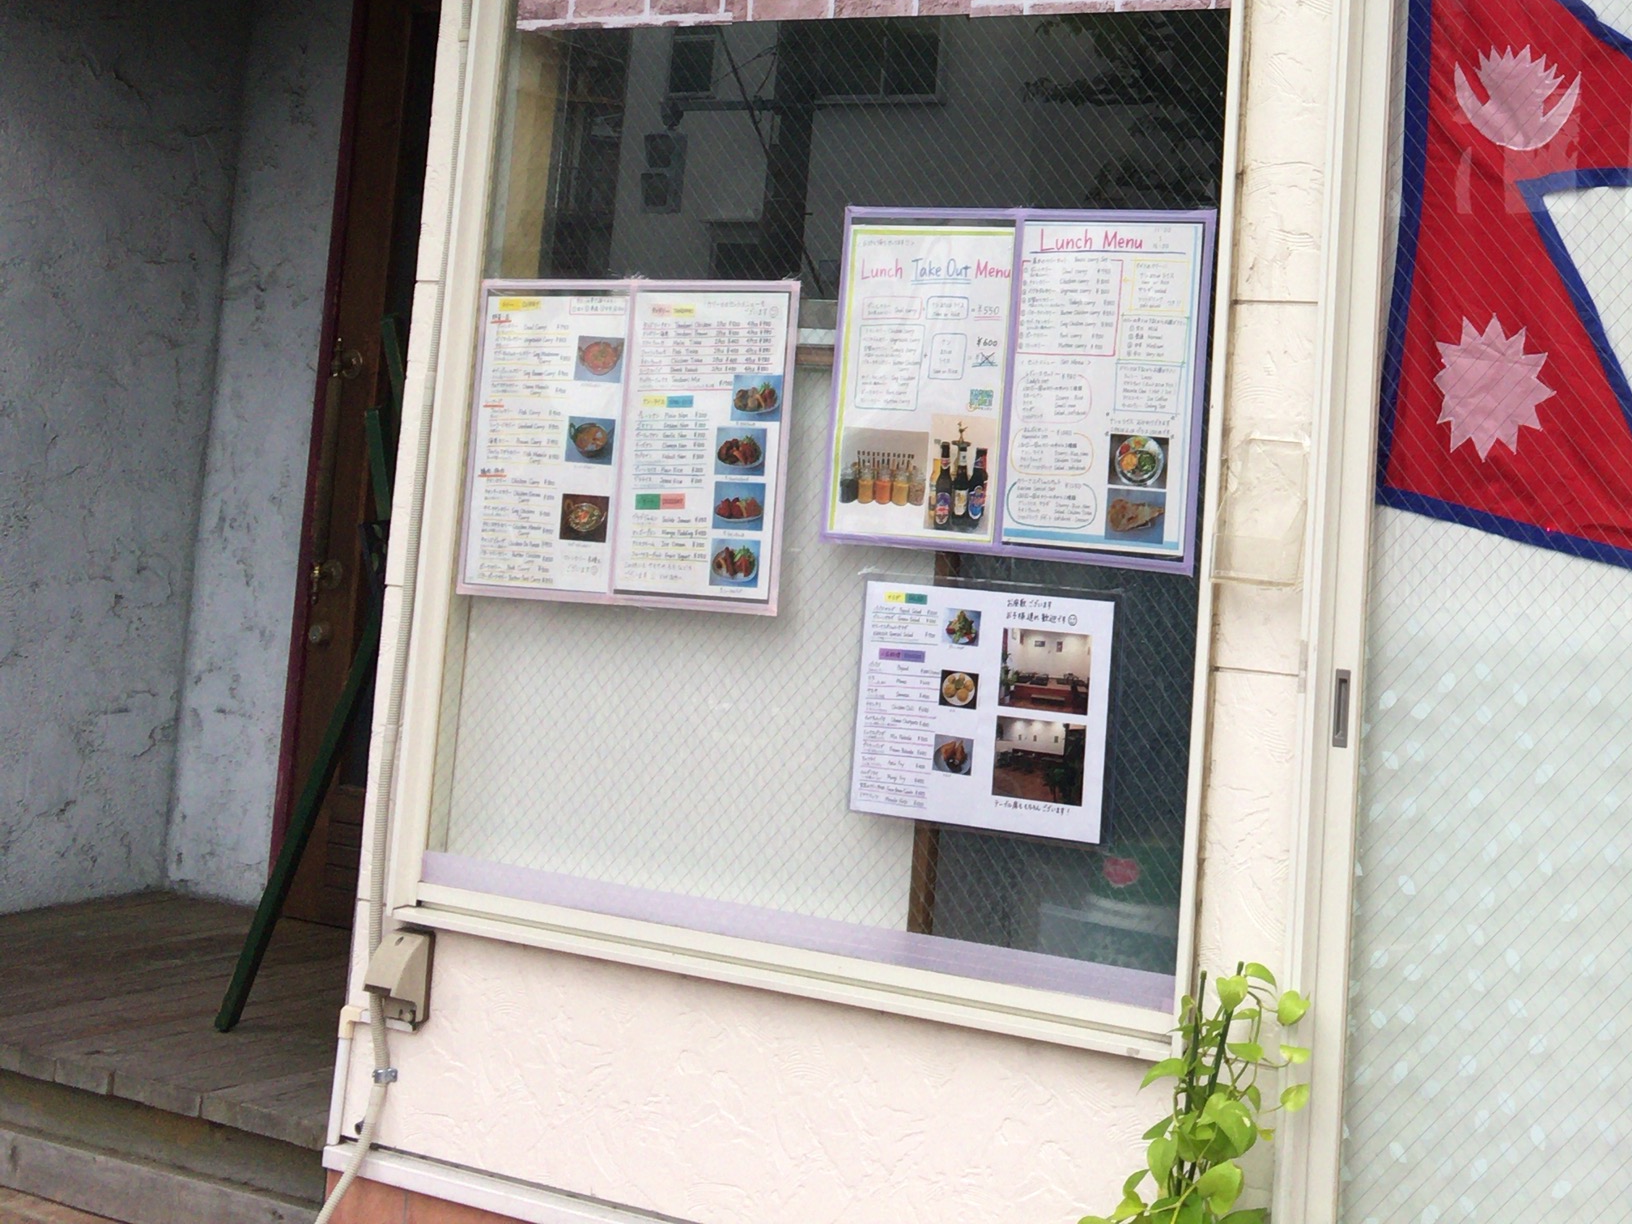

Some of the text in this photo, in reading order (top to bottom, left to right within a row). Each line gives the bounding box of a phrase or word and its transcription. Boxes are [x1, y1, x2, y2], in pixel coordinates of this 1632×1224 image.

[1040, 228, 1144, 252] Lunch Menu
[861, 258, 1011, 280] Lunch Take Out Menu
